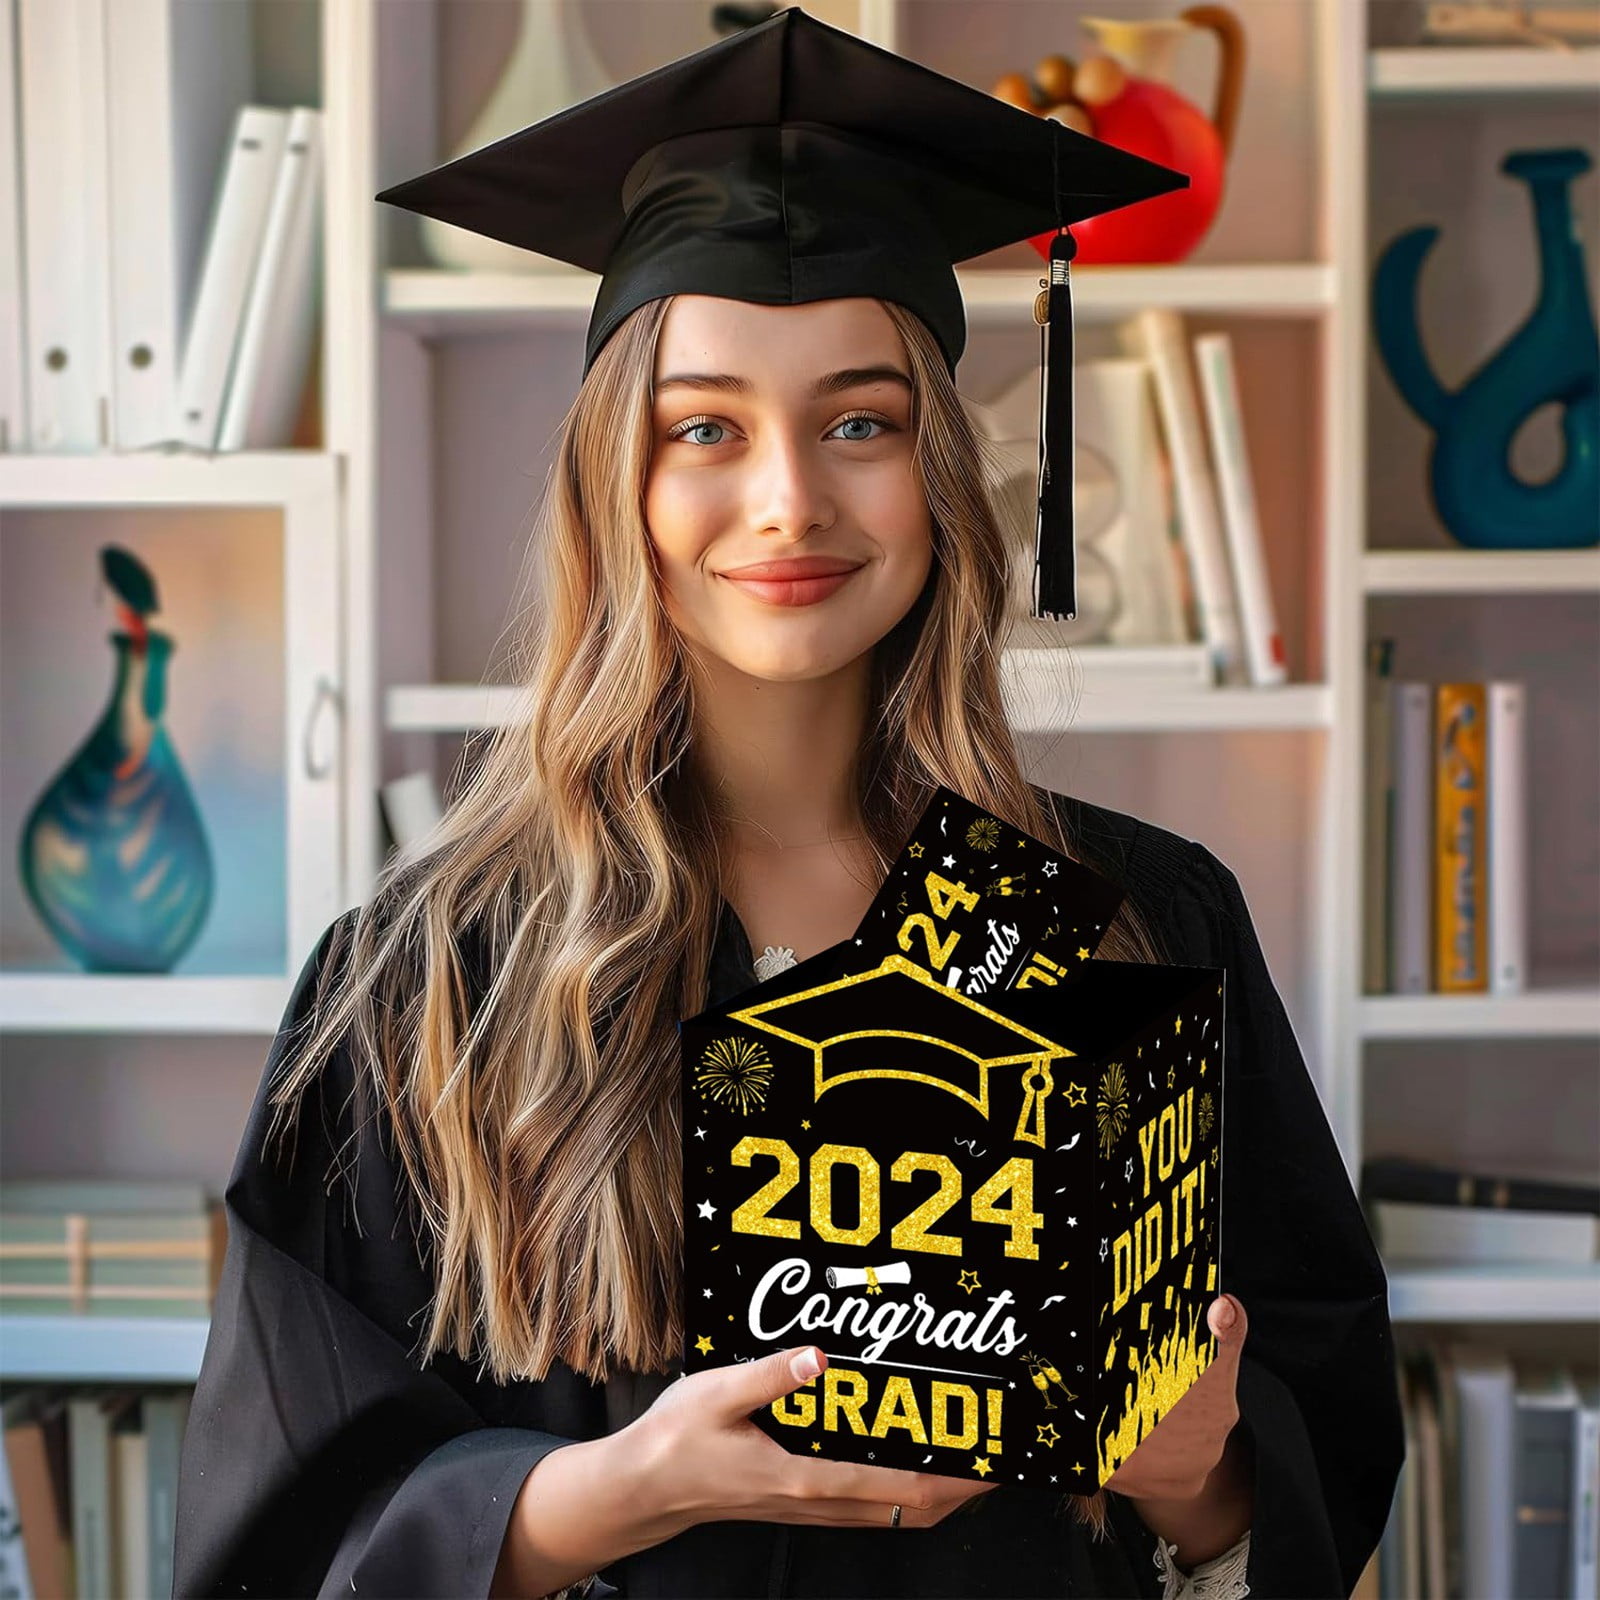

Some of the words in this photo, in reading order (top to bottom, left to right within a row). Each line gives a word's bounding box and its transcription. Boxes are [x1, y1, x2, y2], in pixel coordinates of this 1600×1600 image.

[896, 871, 981, 972] 24
[1138, 1086, 1194, 1198] YOU
[730, 1136, 1044, 1261] 2024
[1112, 1201, 1162, 1316] DID
[1170, 1160, 1206, 1260] IT!
[748, 1258, 1027, 1364] Congrats
[771, 1367, 1004, 1455] GRAD!
